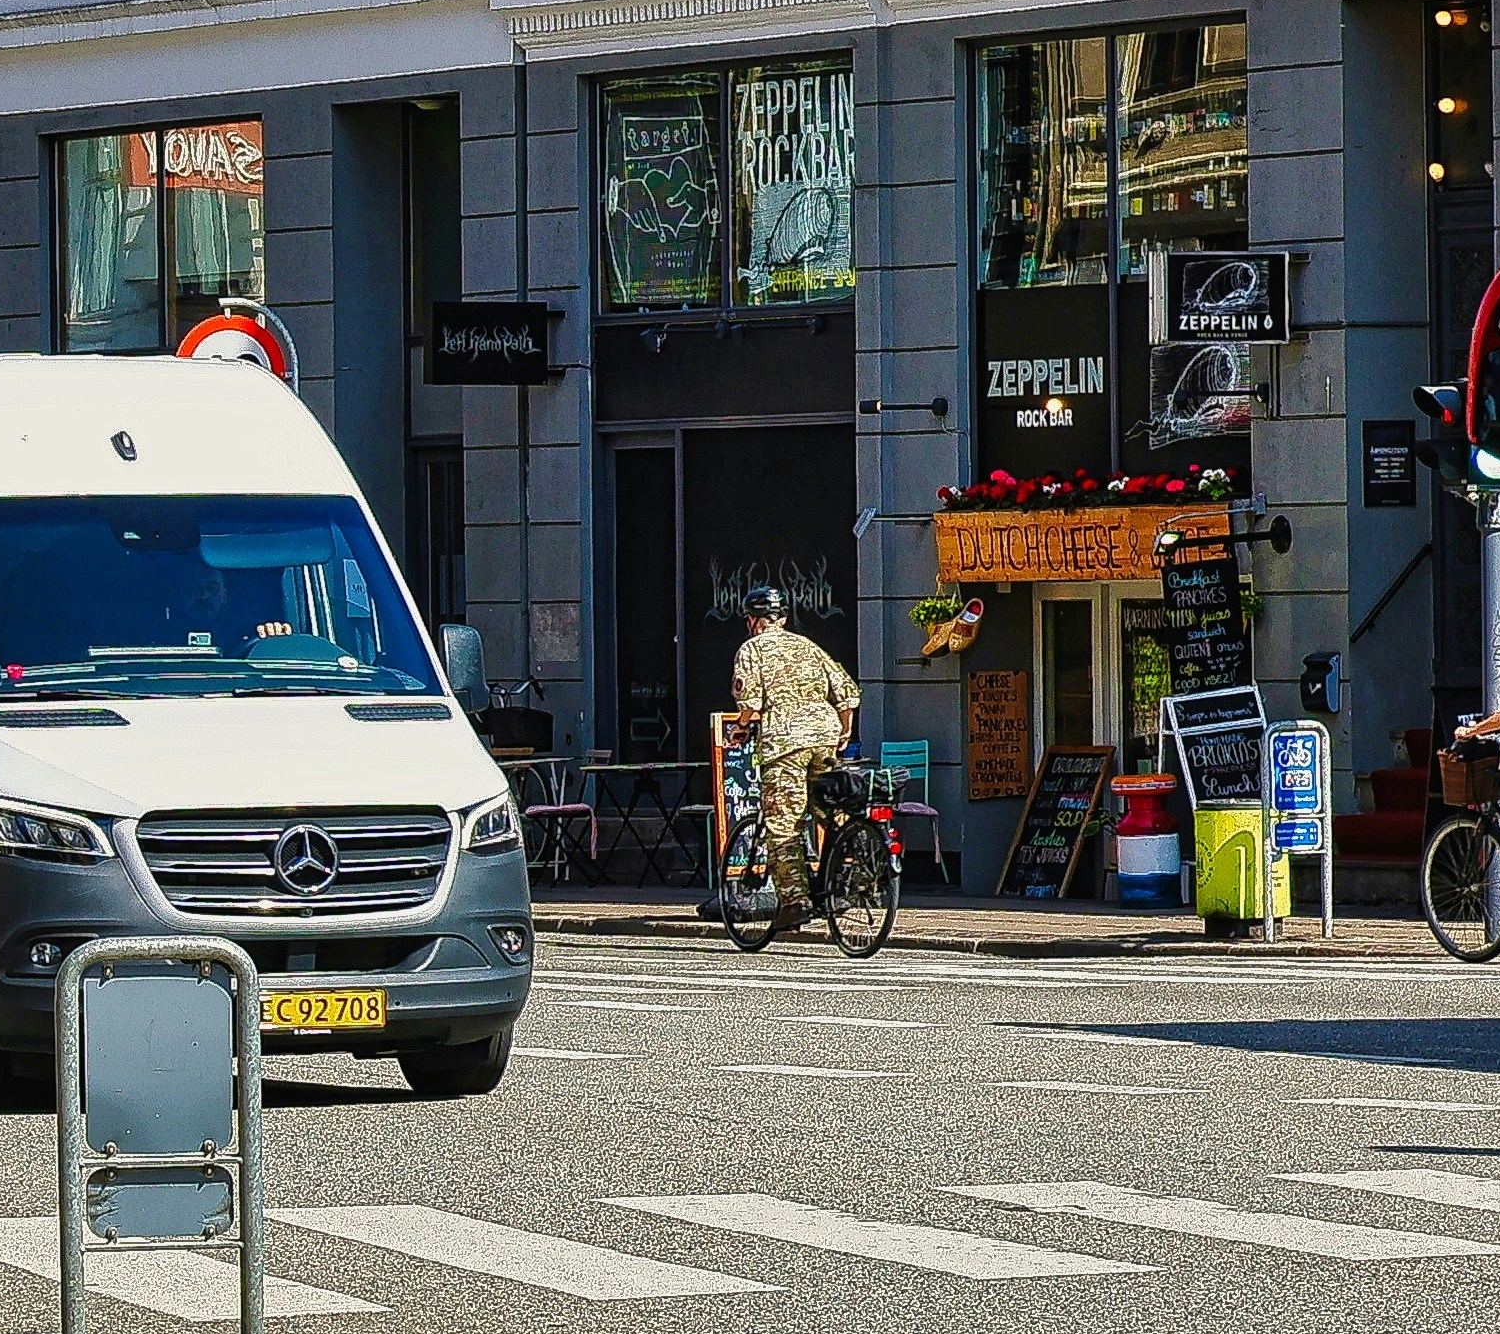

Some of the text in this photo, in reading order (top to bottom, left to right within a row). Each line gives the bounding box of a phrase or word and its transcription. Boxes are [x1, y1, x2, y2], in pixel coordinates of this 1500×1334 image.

[736, 73, 855, 140] ZEPPELIN
[1179, 314, 1258, 331] ZEPPELIN
[987, 356, 1104, 398] ZEPPELIN
[1016, 408, 1074, 428] ROCK BAR
[957, 524, 1041, 572] DUTCH
[1044, 524, 1123, 572] CHEESE
[1128, 528, 1143, 567] &
